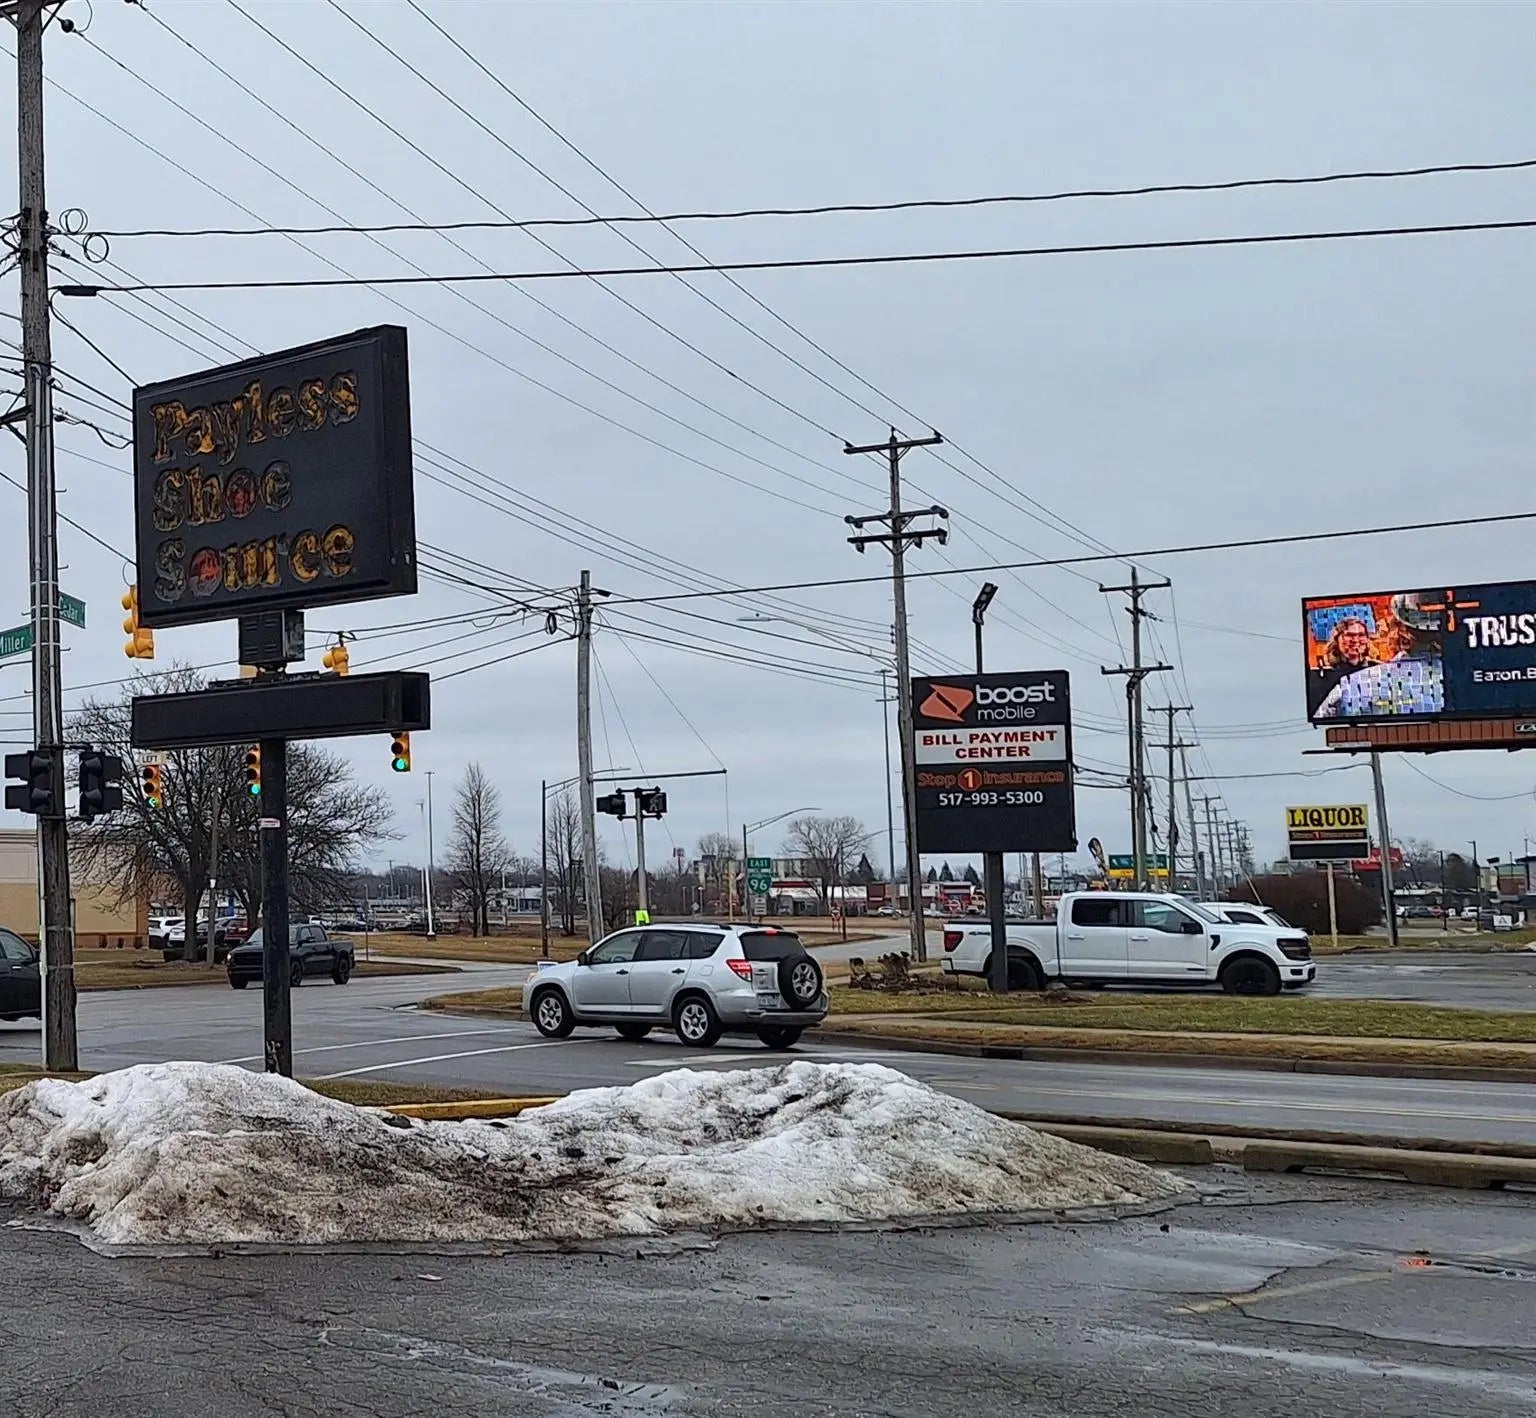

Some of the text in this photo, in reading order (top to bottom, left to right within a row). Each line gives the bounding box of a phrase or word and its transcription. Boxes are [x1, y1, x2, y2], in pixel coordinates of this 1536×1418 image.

[149, 370, 360, 466] Payless
[152, 457, 293, 532] Shoe
[154, 524, 357, 603] Source
[1463, 613, 1536, 648] TRUS
[975, 681, 1055, 704] boost
[977, 705, 1036, 721] mobile
[923, 730, 1057, 746] BILL PAYMENT
[955, 745, 1031, 759] CENTER
[917, 769, 1064, 788] Stop 1 Insurance
[939, 791, 1044, 806] 517-993-5300
[1289, 807, 1366, 827] LIQUOR
[750, 879, 768, 890] 96
